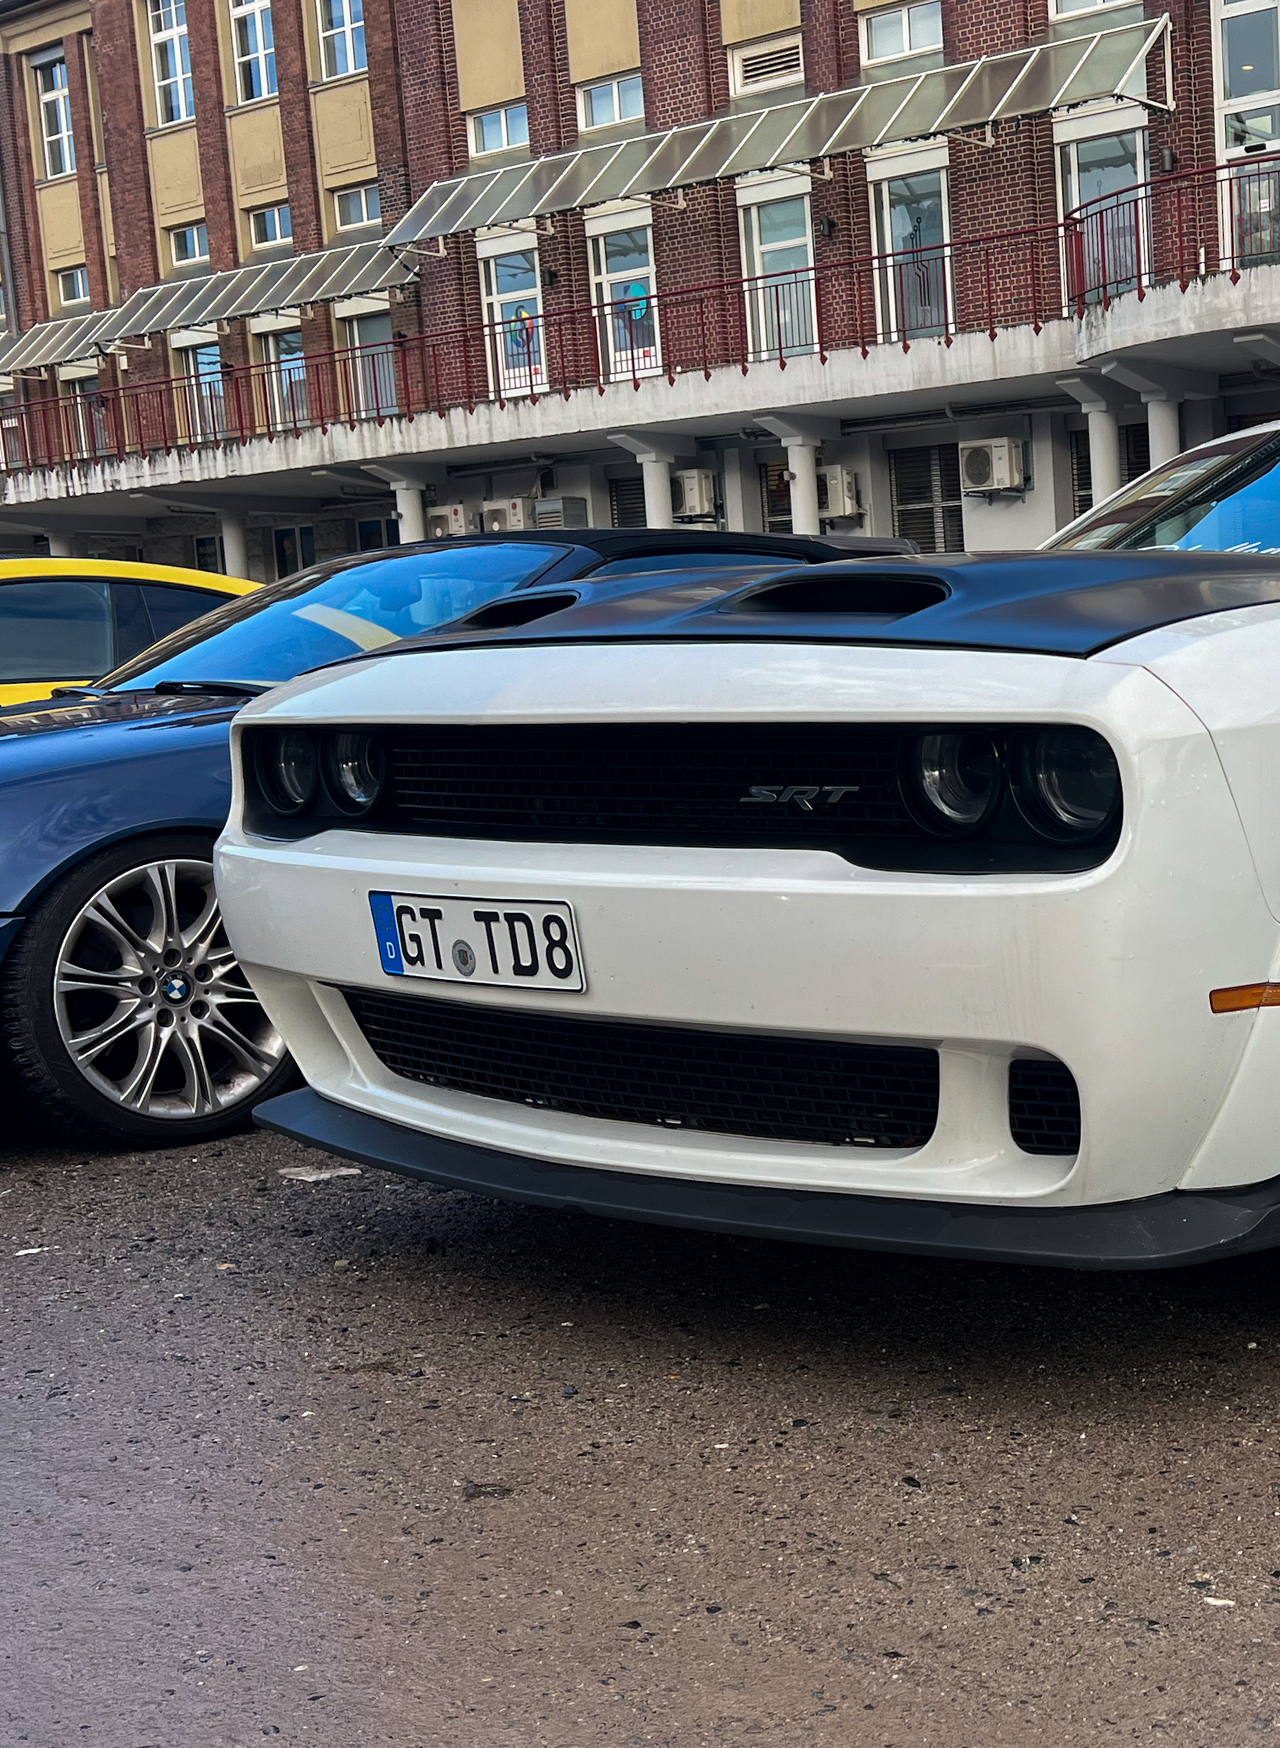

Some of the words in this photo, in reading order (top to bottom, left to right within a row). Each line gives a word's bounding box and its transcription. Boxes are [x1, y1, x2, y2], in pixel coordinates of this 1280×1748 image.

[739, 785, 860, 811] SRT
[386, 941, 396, 959] D
[396, 904, 443, 970] GT
[473, 910, 574, 979] TD8
